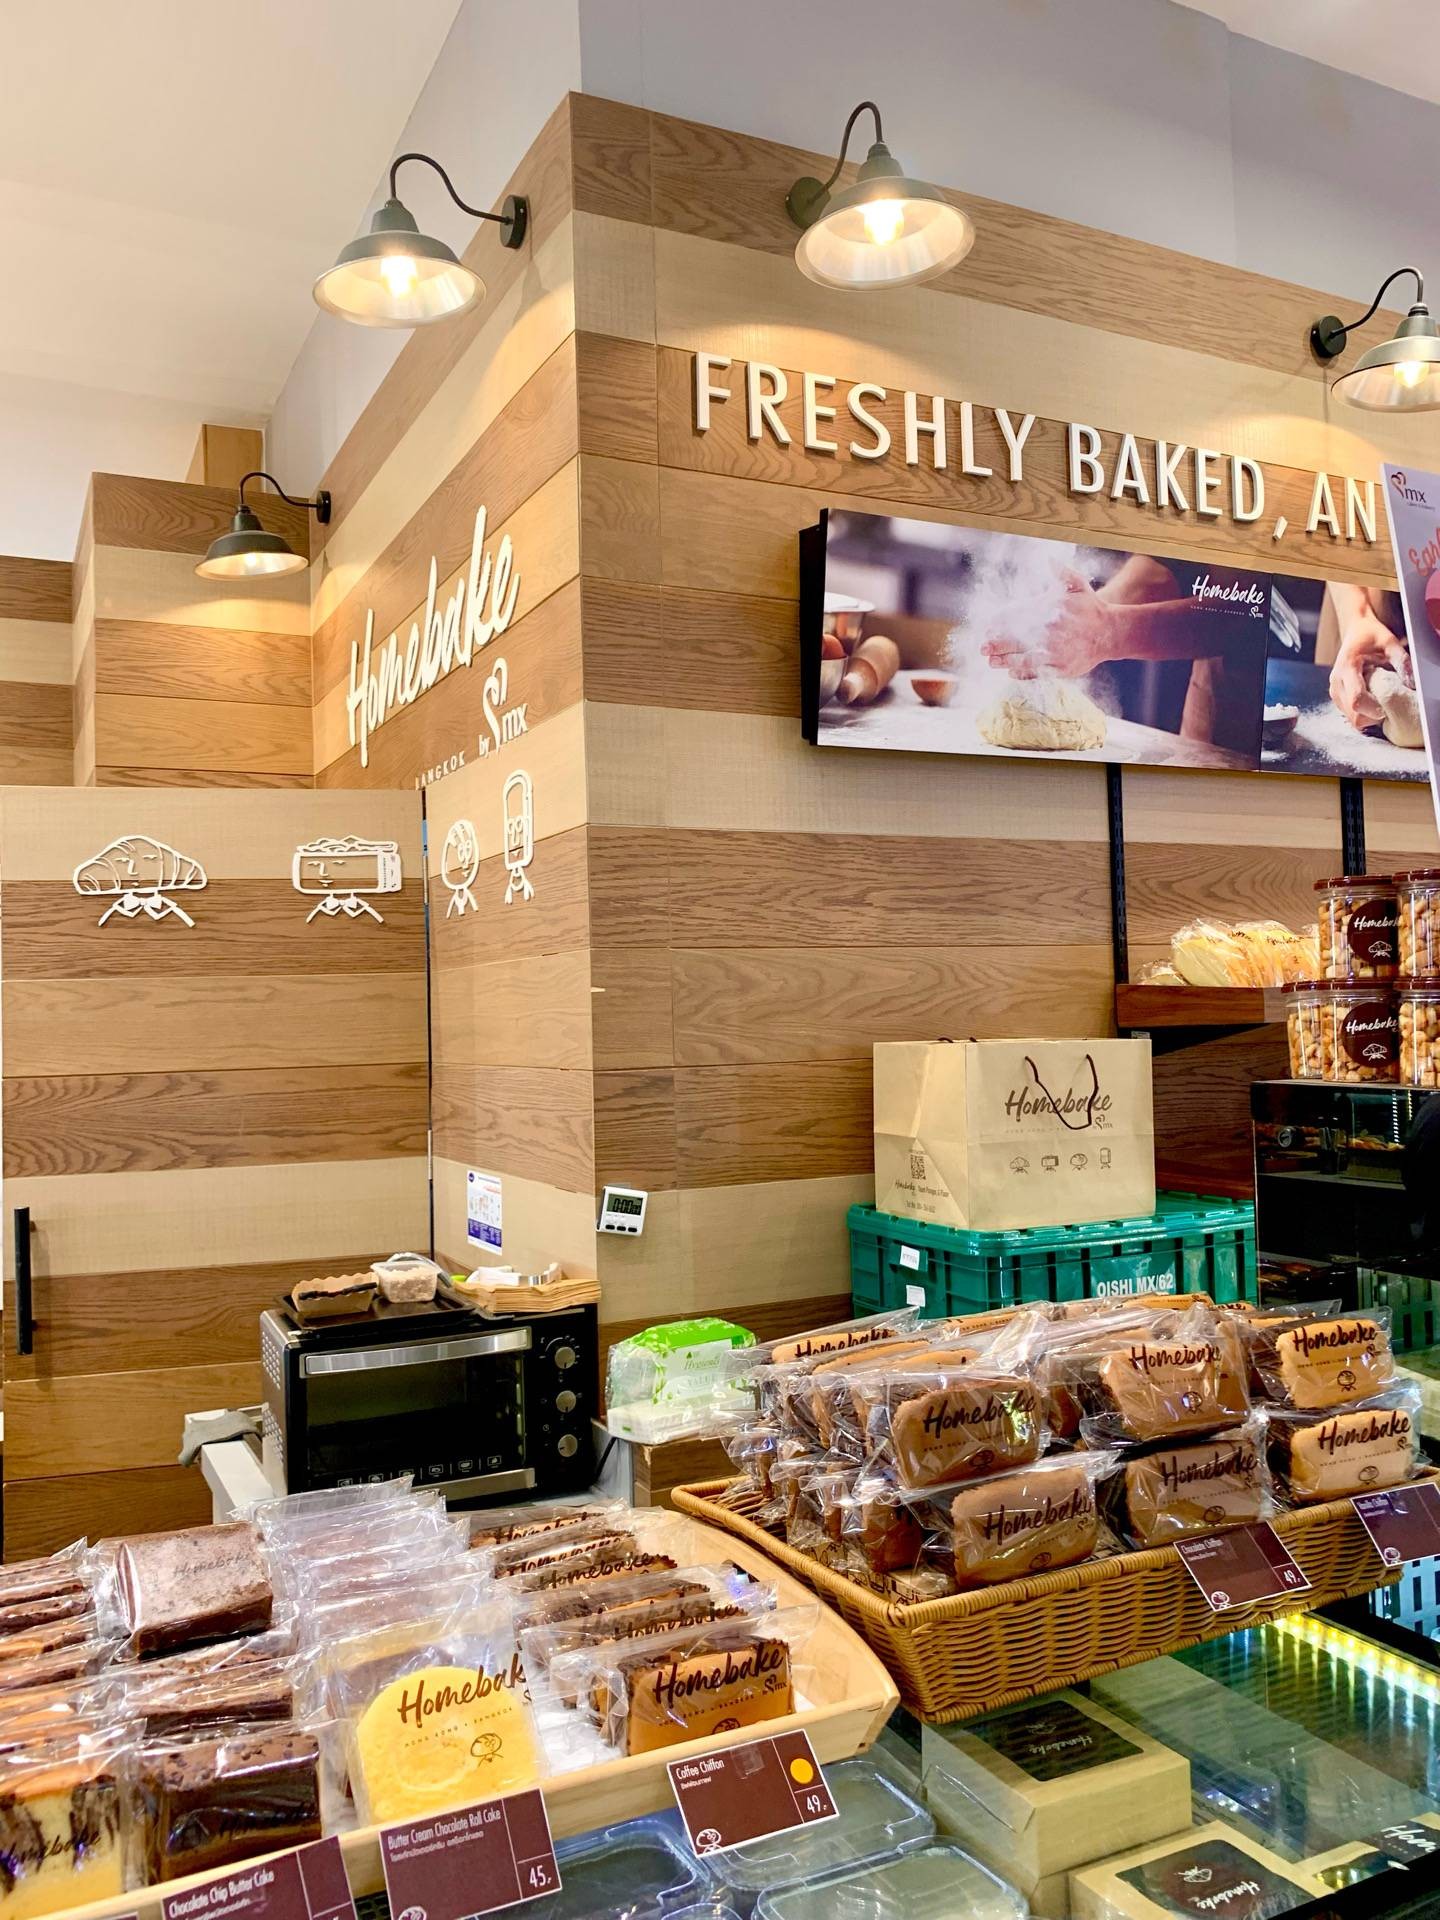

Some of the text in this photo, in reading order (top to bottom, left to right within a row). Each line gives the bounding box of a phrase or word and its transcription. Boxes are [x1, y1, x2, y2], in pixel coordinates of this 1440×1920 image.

[693, 351, 1377, 543] FRESHLY BAKED, AN
[1191, 574, 1265, 604] Homebake
[346, 504, 520, 768] Homebake
[502, 703, 528, 745] mx
[1353, 916, 1400, 931] Homebak
[1345, 1016, 1400, 1035] Homebake
[1096, 1273, 1175, 1297] OISHI MX/62
[1292, 1322, 1378, 1358] Homebake
[922, 1390, 1037, 1439] Homebake
[1317, 1411, 1411, 1456] Homebake
[1160, 1446, 1258, 1493] Homebake
[539, 1551, 651, 1589] Homebake
[397, 1652, 527, 1729] Homebak
[652, 1641, 784, 1709] Homebake
[675, 1757, 725, 1780] Coffee Chiffon
[387, 1832, 410, 1850] Butter
[410, 1827, 434, 1844] Cream
[434, 1817, 469, 1838] Chocolate
[469, 1810, 483, 1828] Roll
[482, 1807, 501, 1824] Cake
[168, 1892, 210, 1919] Chocolate
[208, 1884, 228, 1903] Chip
[227, 1877, 254, 1899] Butter
[253, 1868, 275, 1887] Cake
